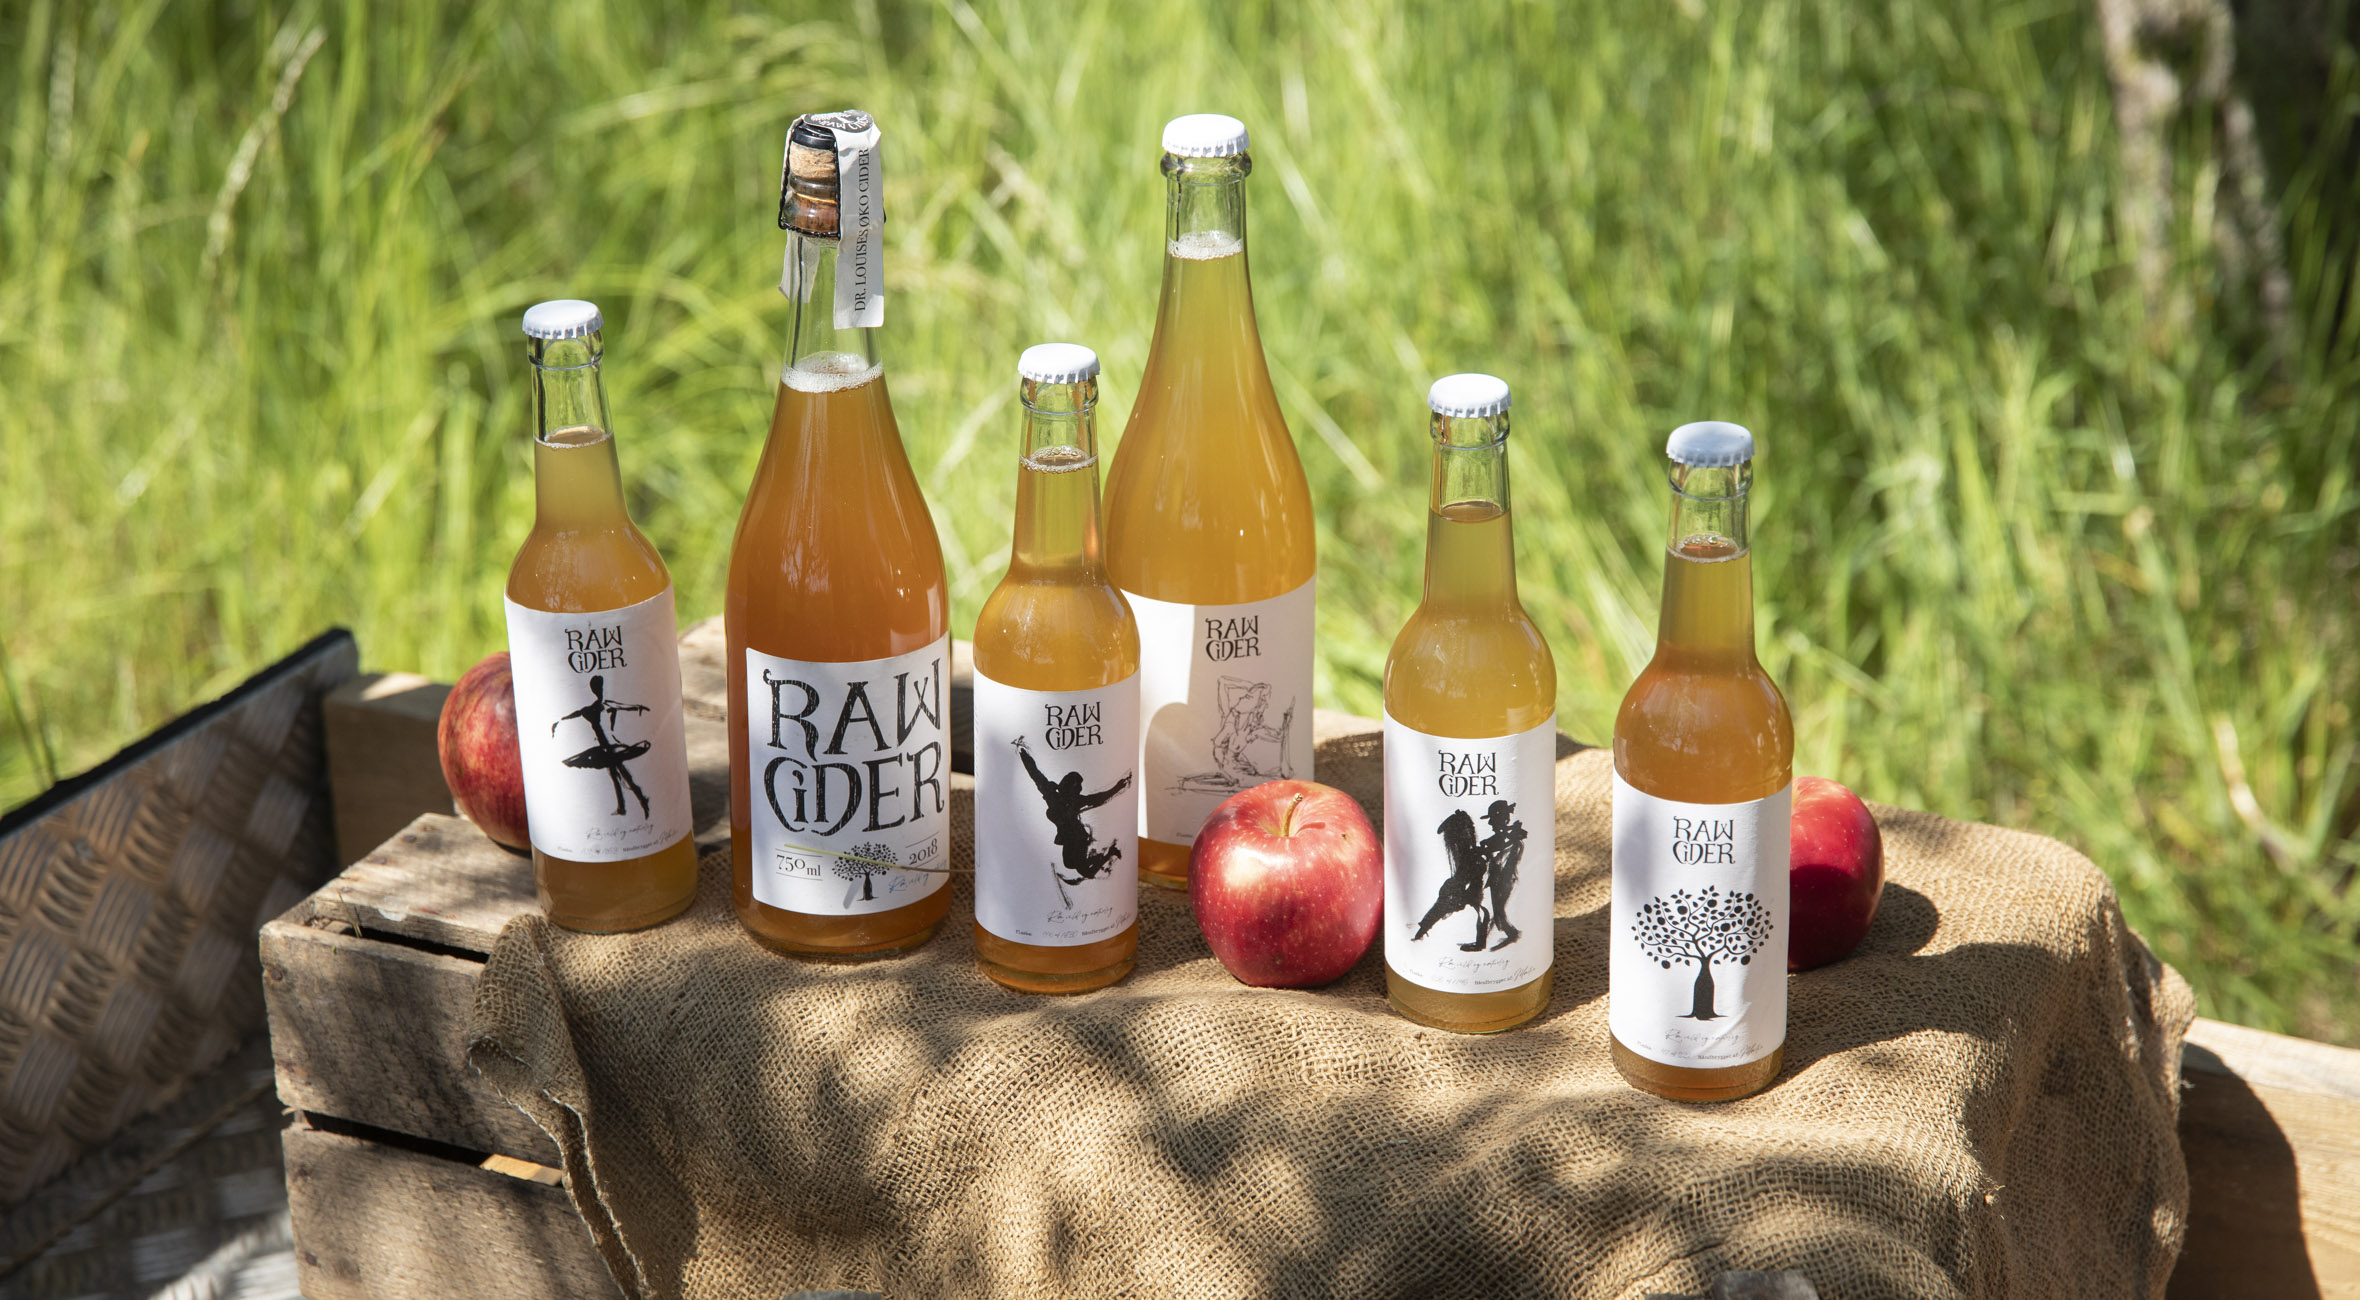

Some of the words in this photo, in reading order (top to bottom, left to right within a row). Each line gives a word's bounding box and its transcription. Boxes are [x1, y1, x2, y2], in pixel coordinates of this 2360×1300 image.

[858, 148, 869, 193] CIDER
[858, 194, 869, 228] ØKO
[855, 229, 868, 287] LOUISES
[855, 287, 867, 311] DR.
[565, 625, 623, 653] RAW
[1204, 615, 1260, 640] RAW
[762, 657, 941, 763] RAW
[1045, 701, 1101, 727] RAW
[1437, 749, 1497, 775] RAW
[1673, 815, 1735, 842] RAW
[908, 838, 938, 866] 2018
